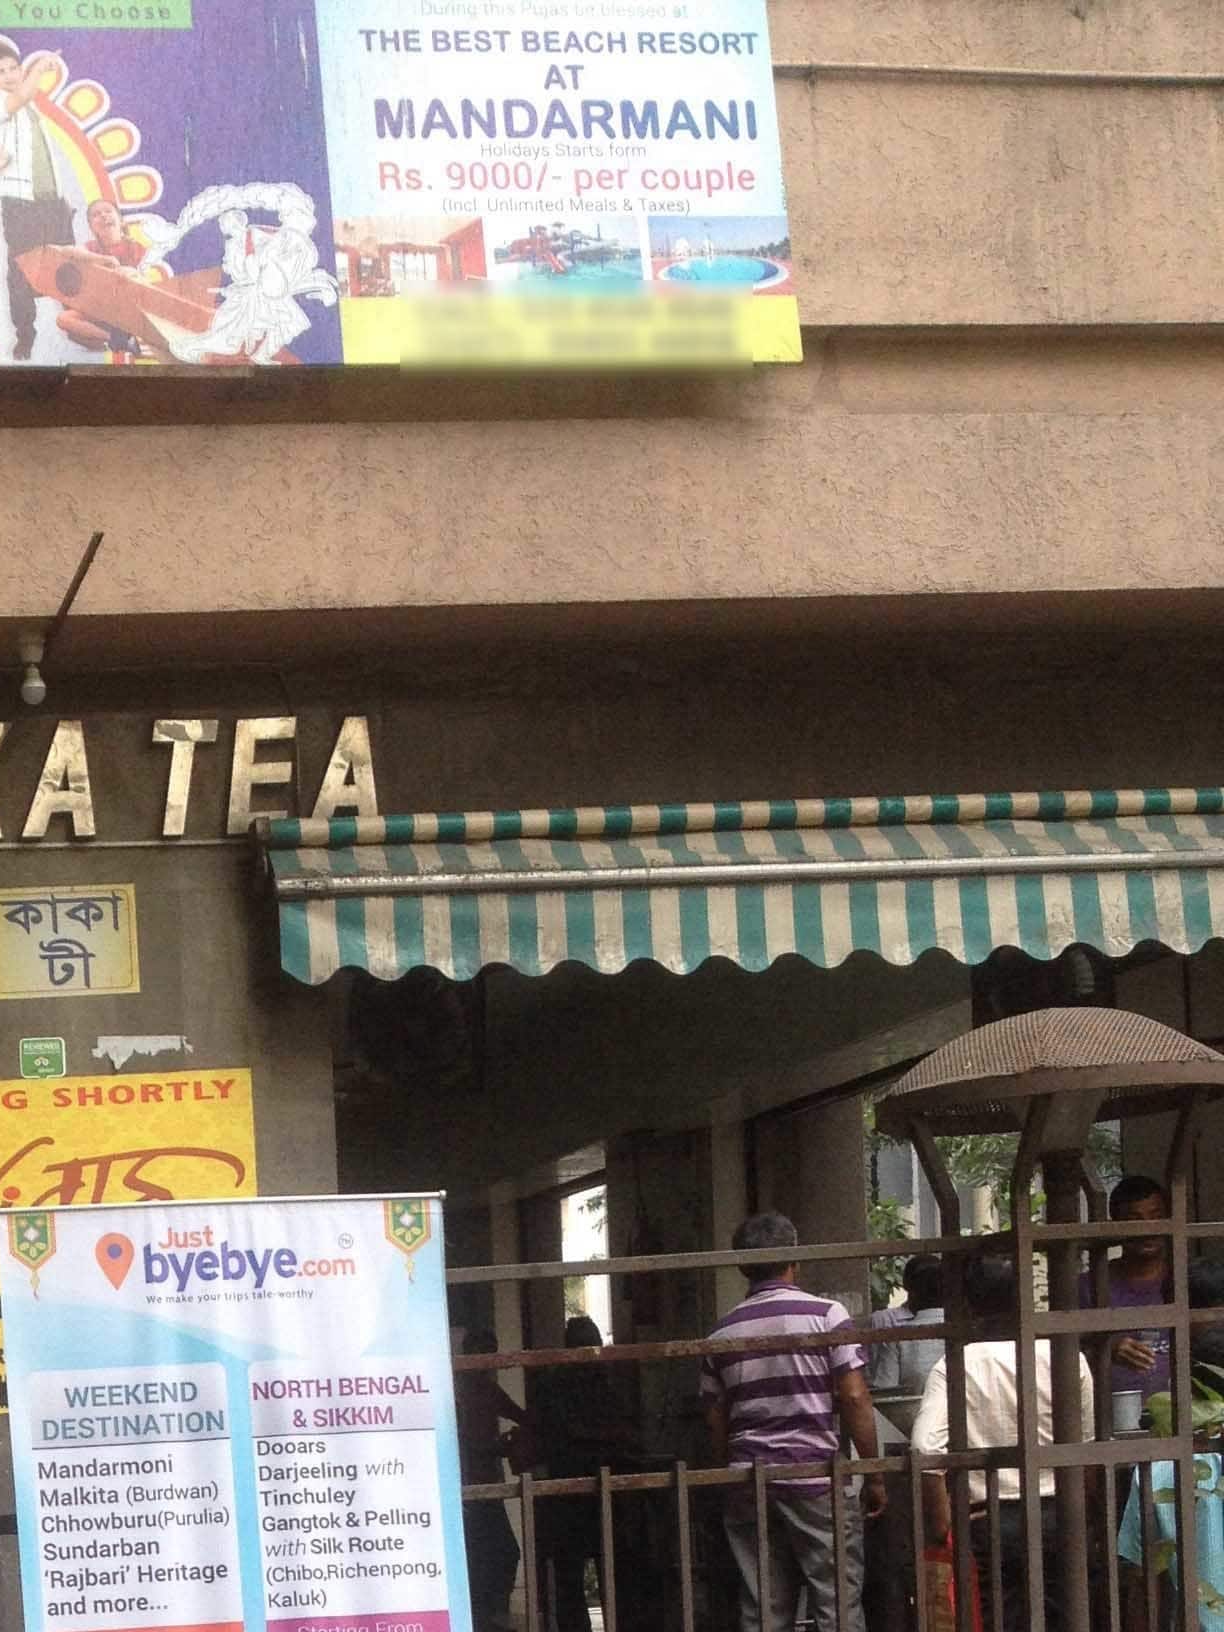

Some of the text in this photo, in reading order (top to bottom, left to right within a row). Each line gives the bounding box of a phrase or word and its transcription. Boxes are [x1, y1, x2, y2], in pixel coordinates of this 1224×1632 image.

[16, 2, 62, 18] You
[76, 2, 171, 20] Choose
[359, 29, 760, 55] THE BEST BEACH RESORT
[543, 63, 586, 91] AT
[373, 97, 759, 141] MANDARMANI
[480, 142, 648, 160] Holidays Starts form
[378, 161, 757, 198] Rs. 9000/- per couple
[487, 197, 566, 214] Unlimited
[569, 197, 619, 214] Meals
[622, 199, 635, 213] &
[640, 198, 692, 215] Taxes)
[150, 715, 382, 837] TEA
[51, 1077, 237, 1109] SHORTLY
[158, 1225, 214, 1249] Just
[145, 1295, 163, 1304] We
[165, 1294, 194, 1304] make
[197, 1292, 221, 1304] your
[224, 1290, 250, 1304] trips
[64, 1381, 198, 1408] WEEKEND
[252, 1375, 430, 1401] NORTH BENGAL
[41, 1410, 225, 1441] DESTINATION
[292, 1406, 394, 1429] & SIKKIM
[257, 1438, 326, 1456] Dooars
[37, 1453, 174, 1480] Mandarmoni
[258, 1457, 405, 1484] Darjeeling with
[39, 1480, 219, 1507] Malkita (Burdwan)
[260, 1487, 356, 1508] Tinchuley
[262, 1508, 432, 1534] Gangtok & Pelling
[43, 1538, 160, 1562] Sundarban
[265, 1535, 405, 1558] with Silk Route
[137, 1562, 228, 1587] Heritage
[47, 1596, 86, 1617] and
[267, 1588, 328, 1610] Kaluk)
